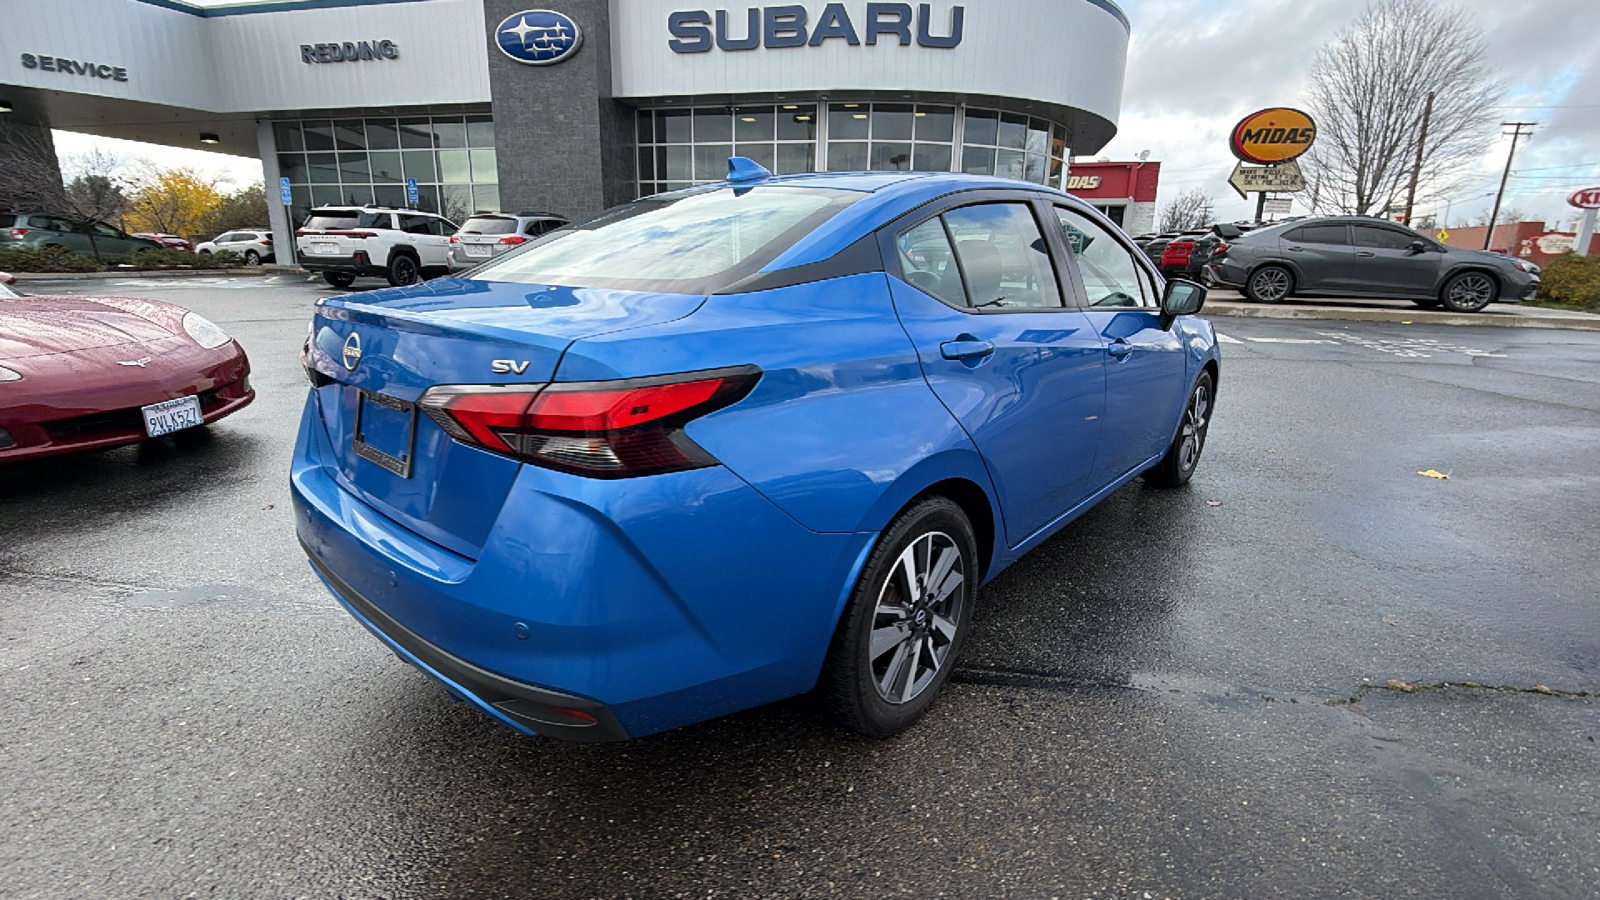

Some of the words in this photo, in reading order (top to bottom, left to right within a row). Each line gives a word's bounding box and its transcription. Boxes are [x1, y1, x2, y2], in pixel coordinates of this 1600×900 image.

[668, 2, 964, 53] SUBARU
[300, 40, 398, 63] REDDING
[21, 53, 129, 82] SERVICE
[1242, 127, 1314, 144] MIDAS
[1068, 175, 1101, 189] DAS
[491, 359, 531, 375] SV
[149, 407, 197, 433] 9VLK527
